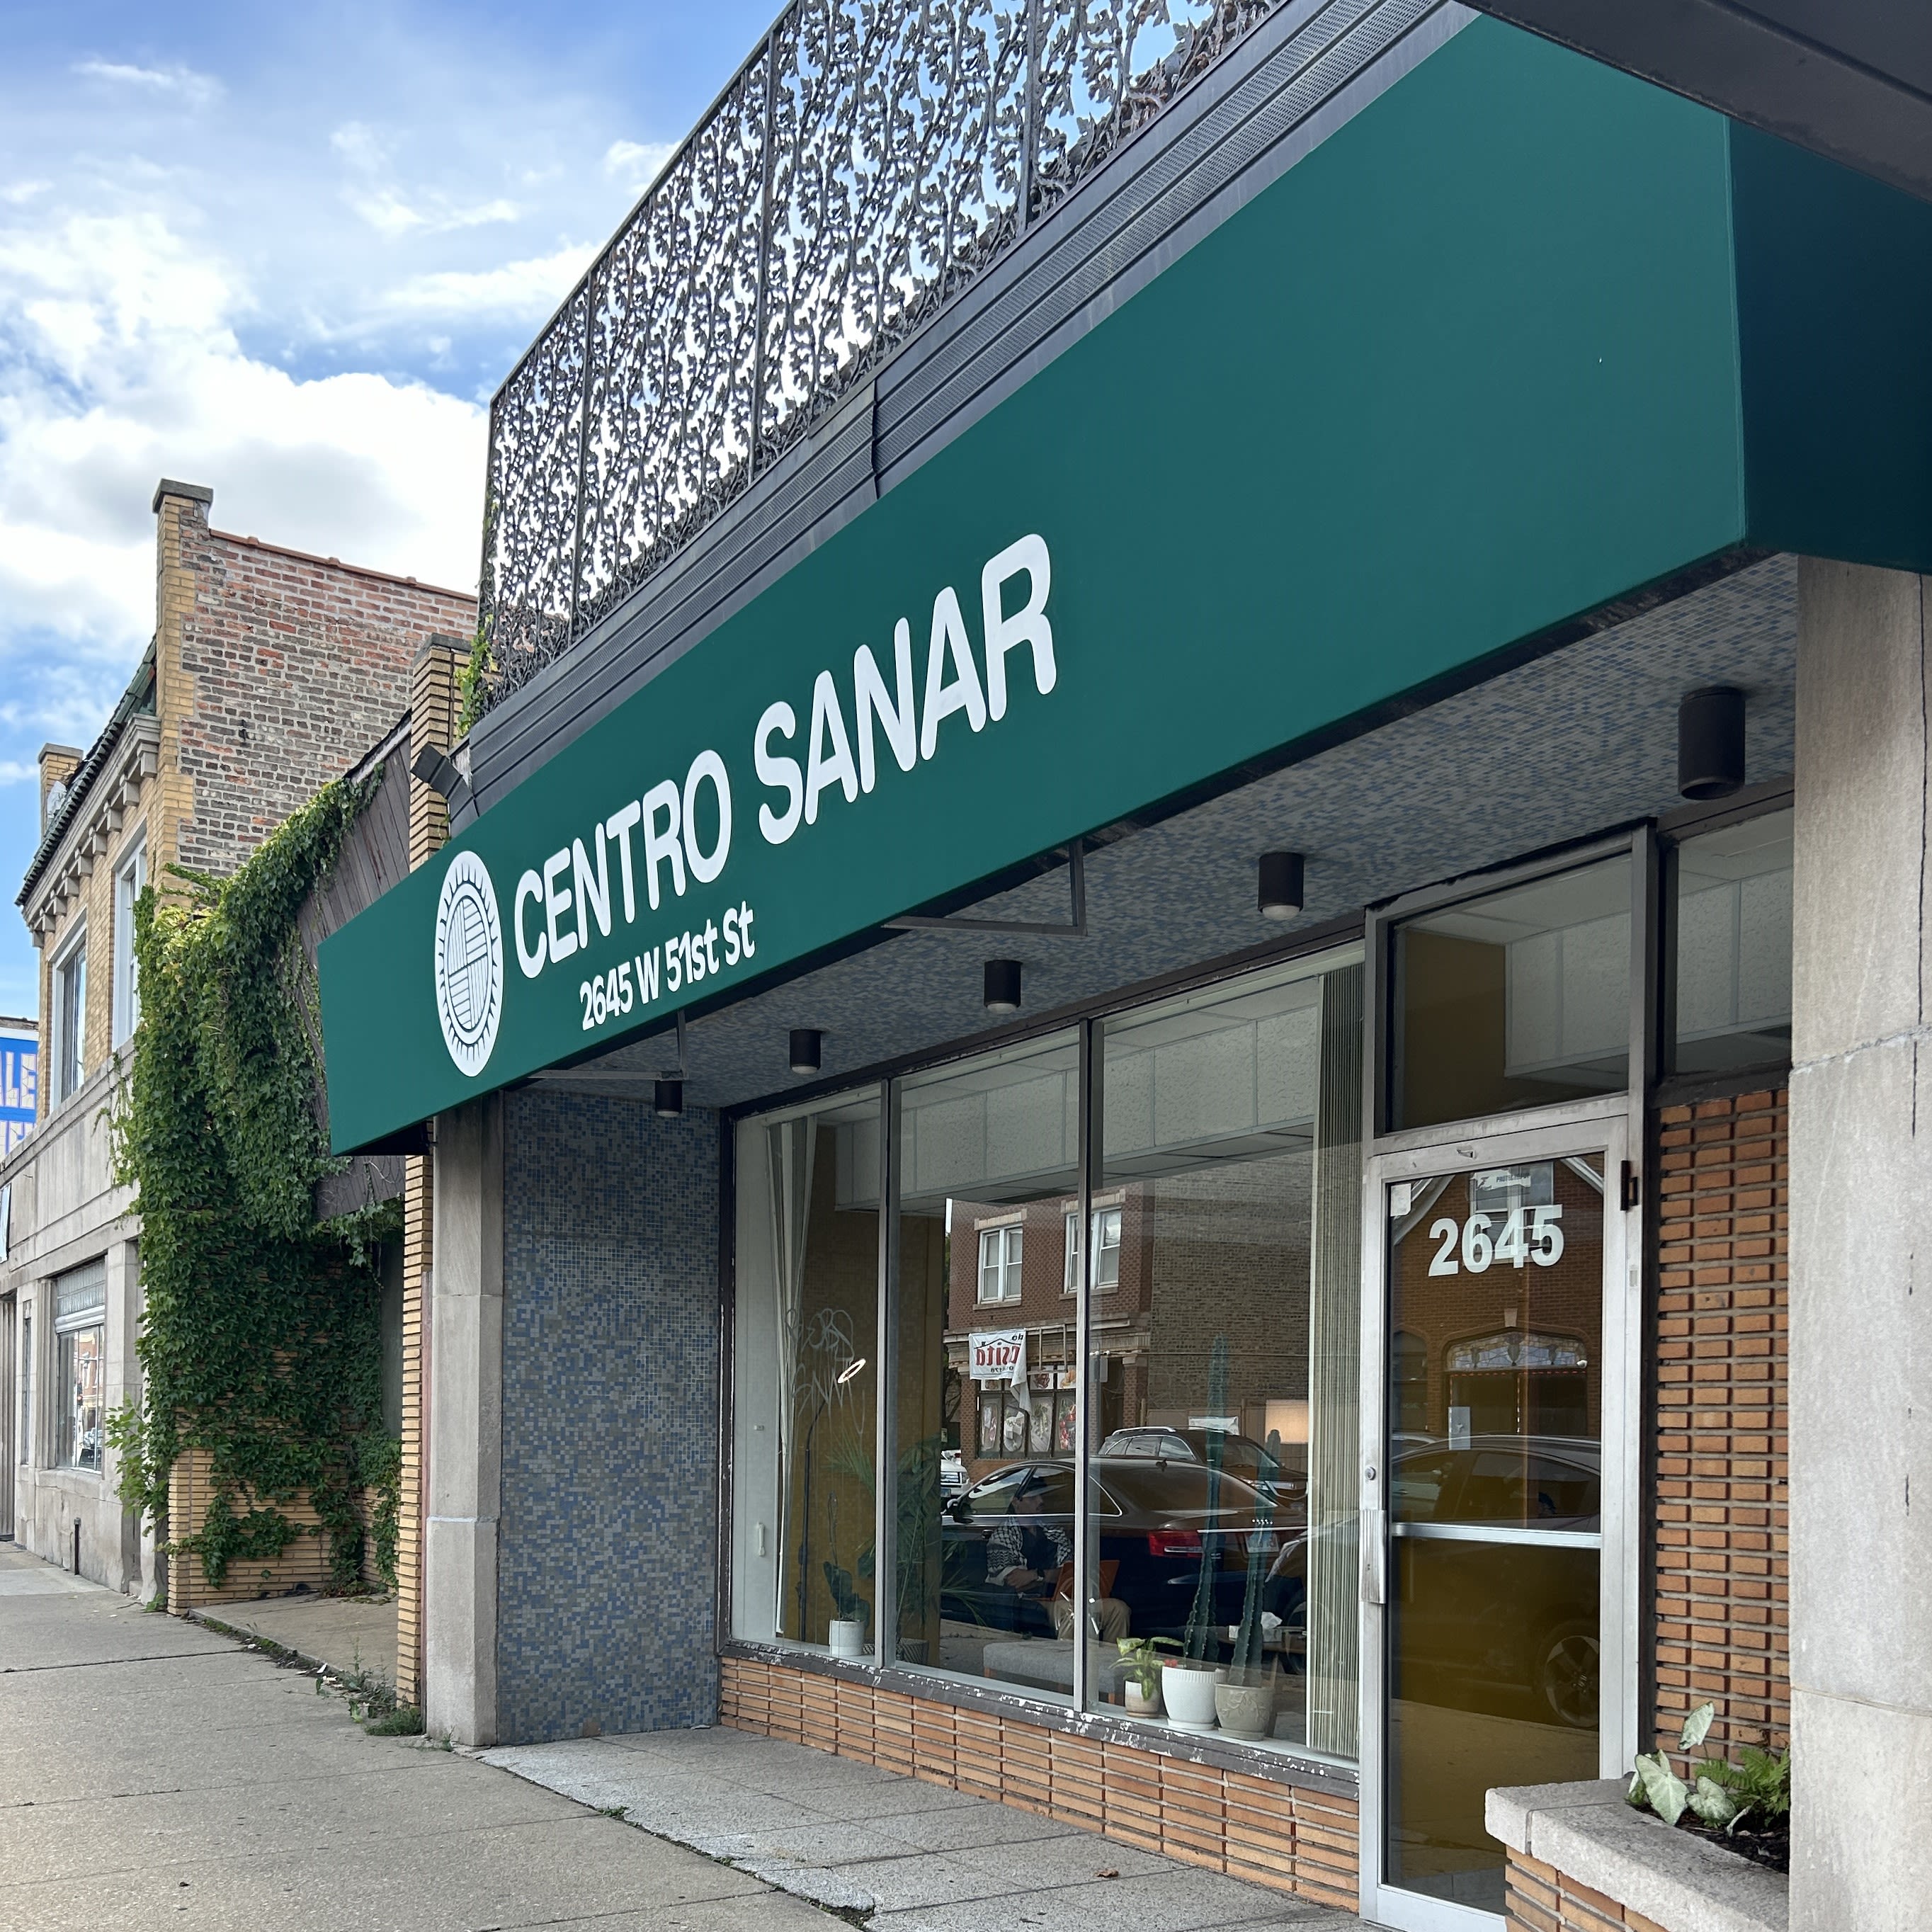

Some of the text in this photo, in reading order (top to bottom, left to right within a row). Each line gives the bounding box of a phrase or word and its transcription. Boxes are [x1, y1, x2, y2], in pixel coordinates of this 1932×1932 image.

[514, 533, 1057, 979] CENTRO SANAR
[579, 900, 756, 1031] 2645 W 51st St
[1428, 1204, 1564, 1277] 2645
